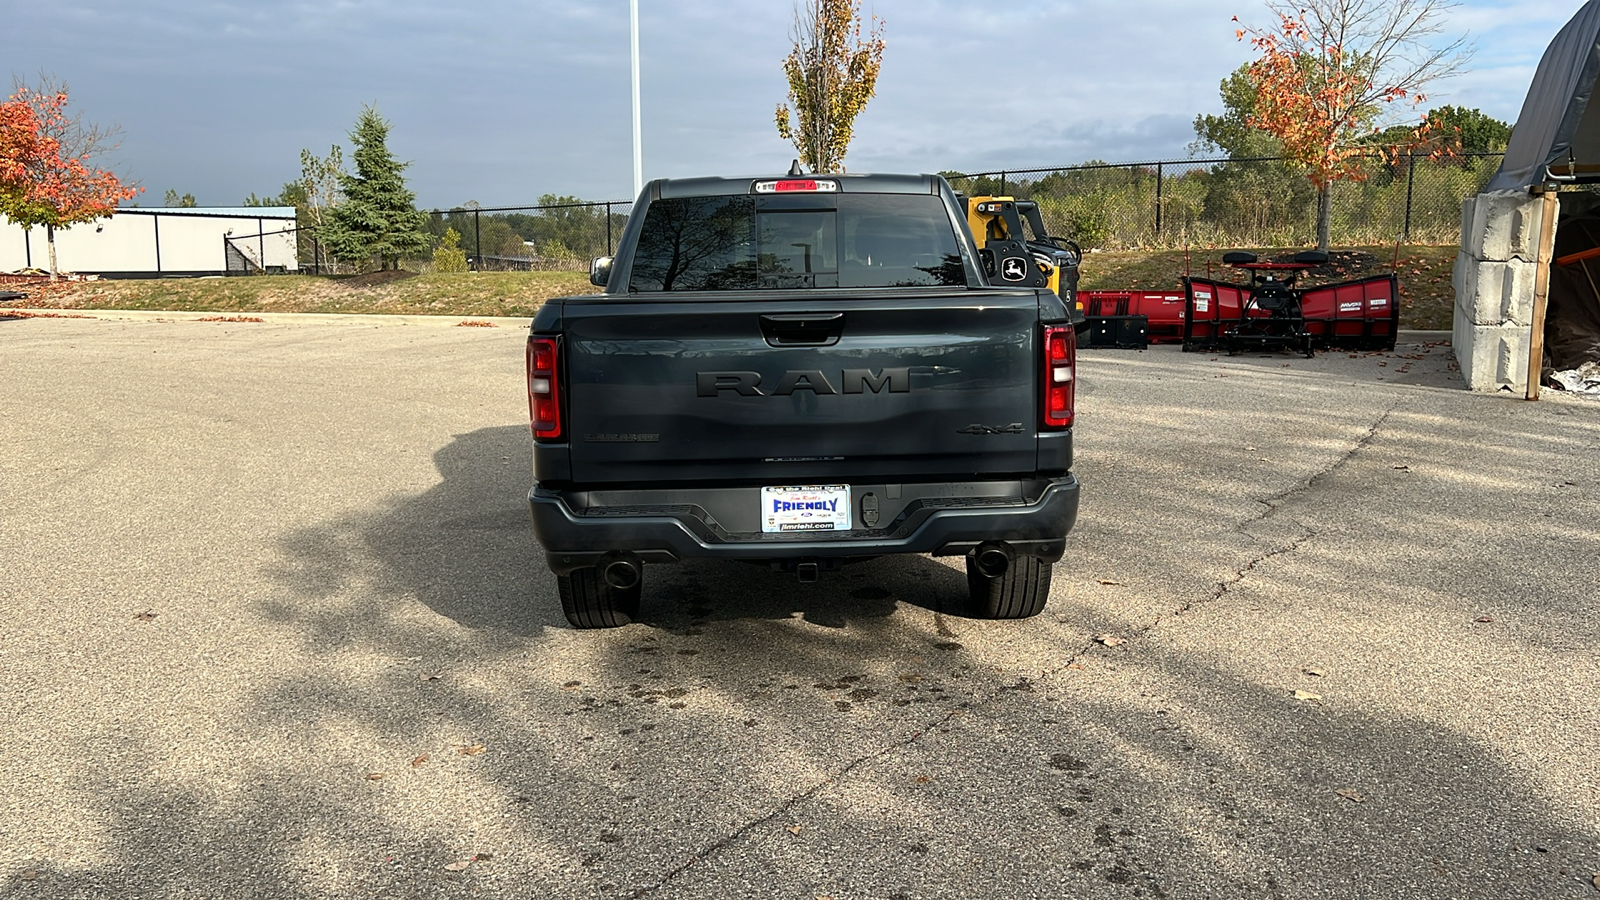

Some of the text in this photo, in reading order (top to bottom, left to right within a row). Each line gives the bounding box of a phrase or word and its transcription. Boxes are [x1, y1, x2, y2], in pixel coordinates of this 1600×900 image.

[696, 367, 911, 398] RAM
[773, 497, 839, 513] FRIENDLY
[781, 523, 833, 531] jimriehl.com
